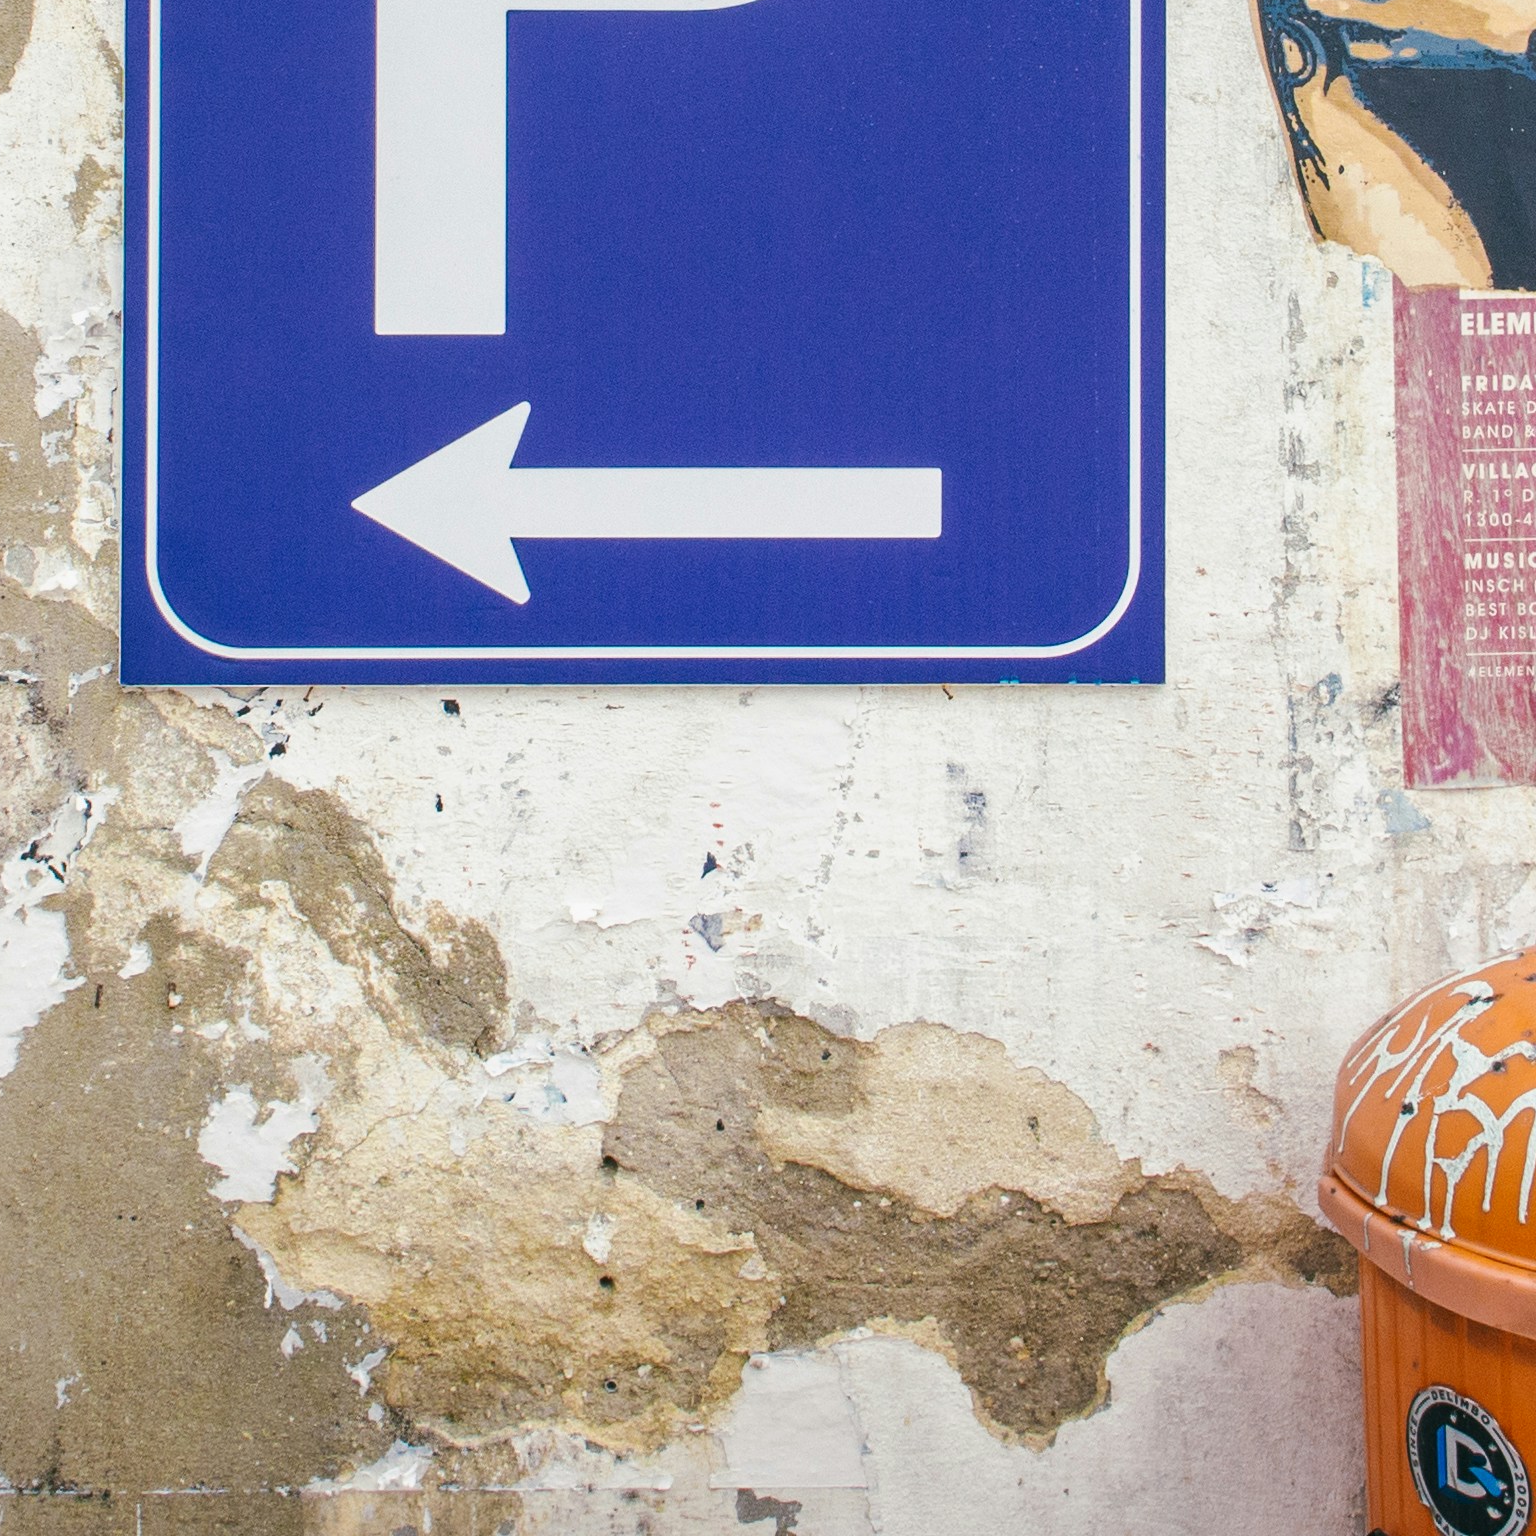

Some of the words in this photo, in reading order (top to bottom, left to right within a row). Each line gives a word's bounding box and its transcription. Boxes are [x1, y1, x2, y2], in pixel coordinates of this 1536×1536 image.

[1461, 401, 1515, 416] SKATE
[1462, 424, 1514, 439] BAND
[1525, 425, 1536, 438] &
[1463, 489, 1480, 504] R.
[1465, 578, 1525, 593] INSCH
[1465, 602, 1507, 618] BEST
[1465, 627, 1488, 641] DJ
[1431, 1390, 1490, 1425] DELIMBO
